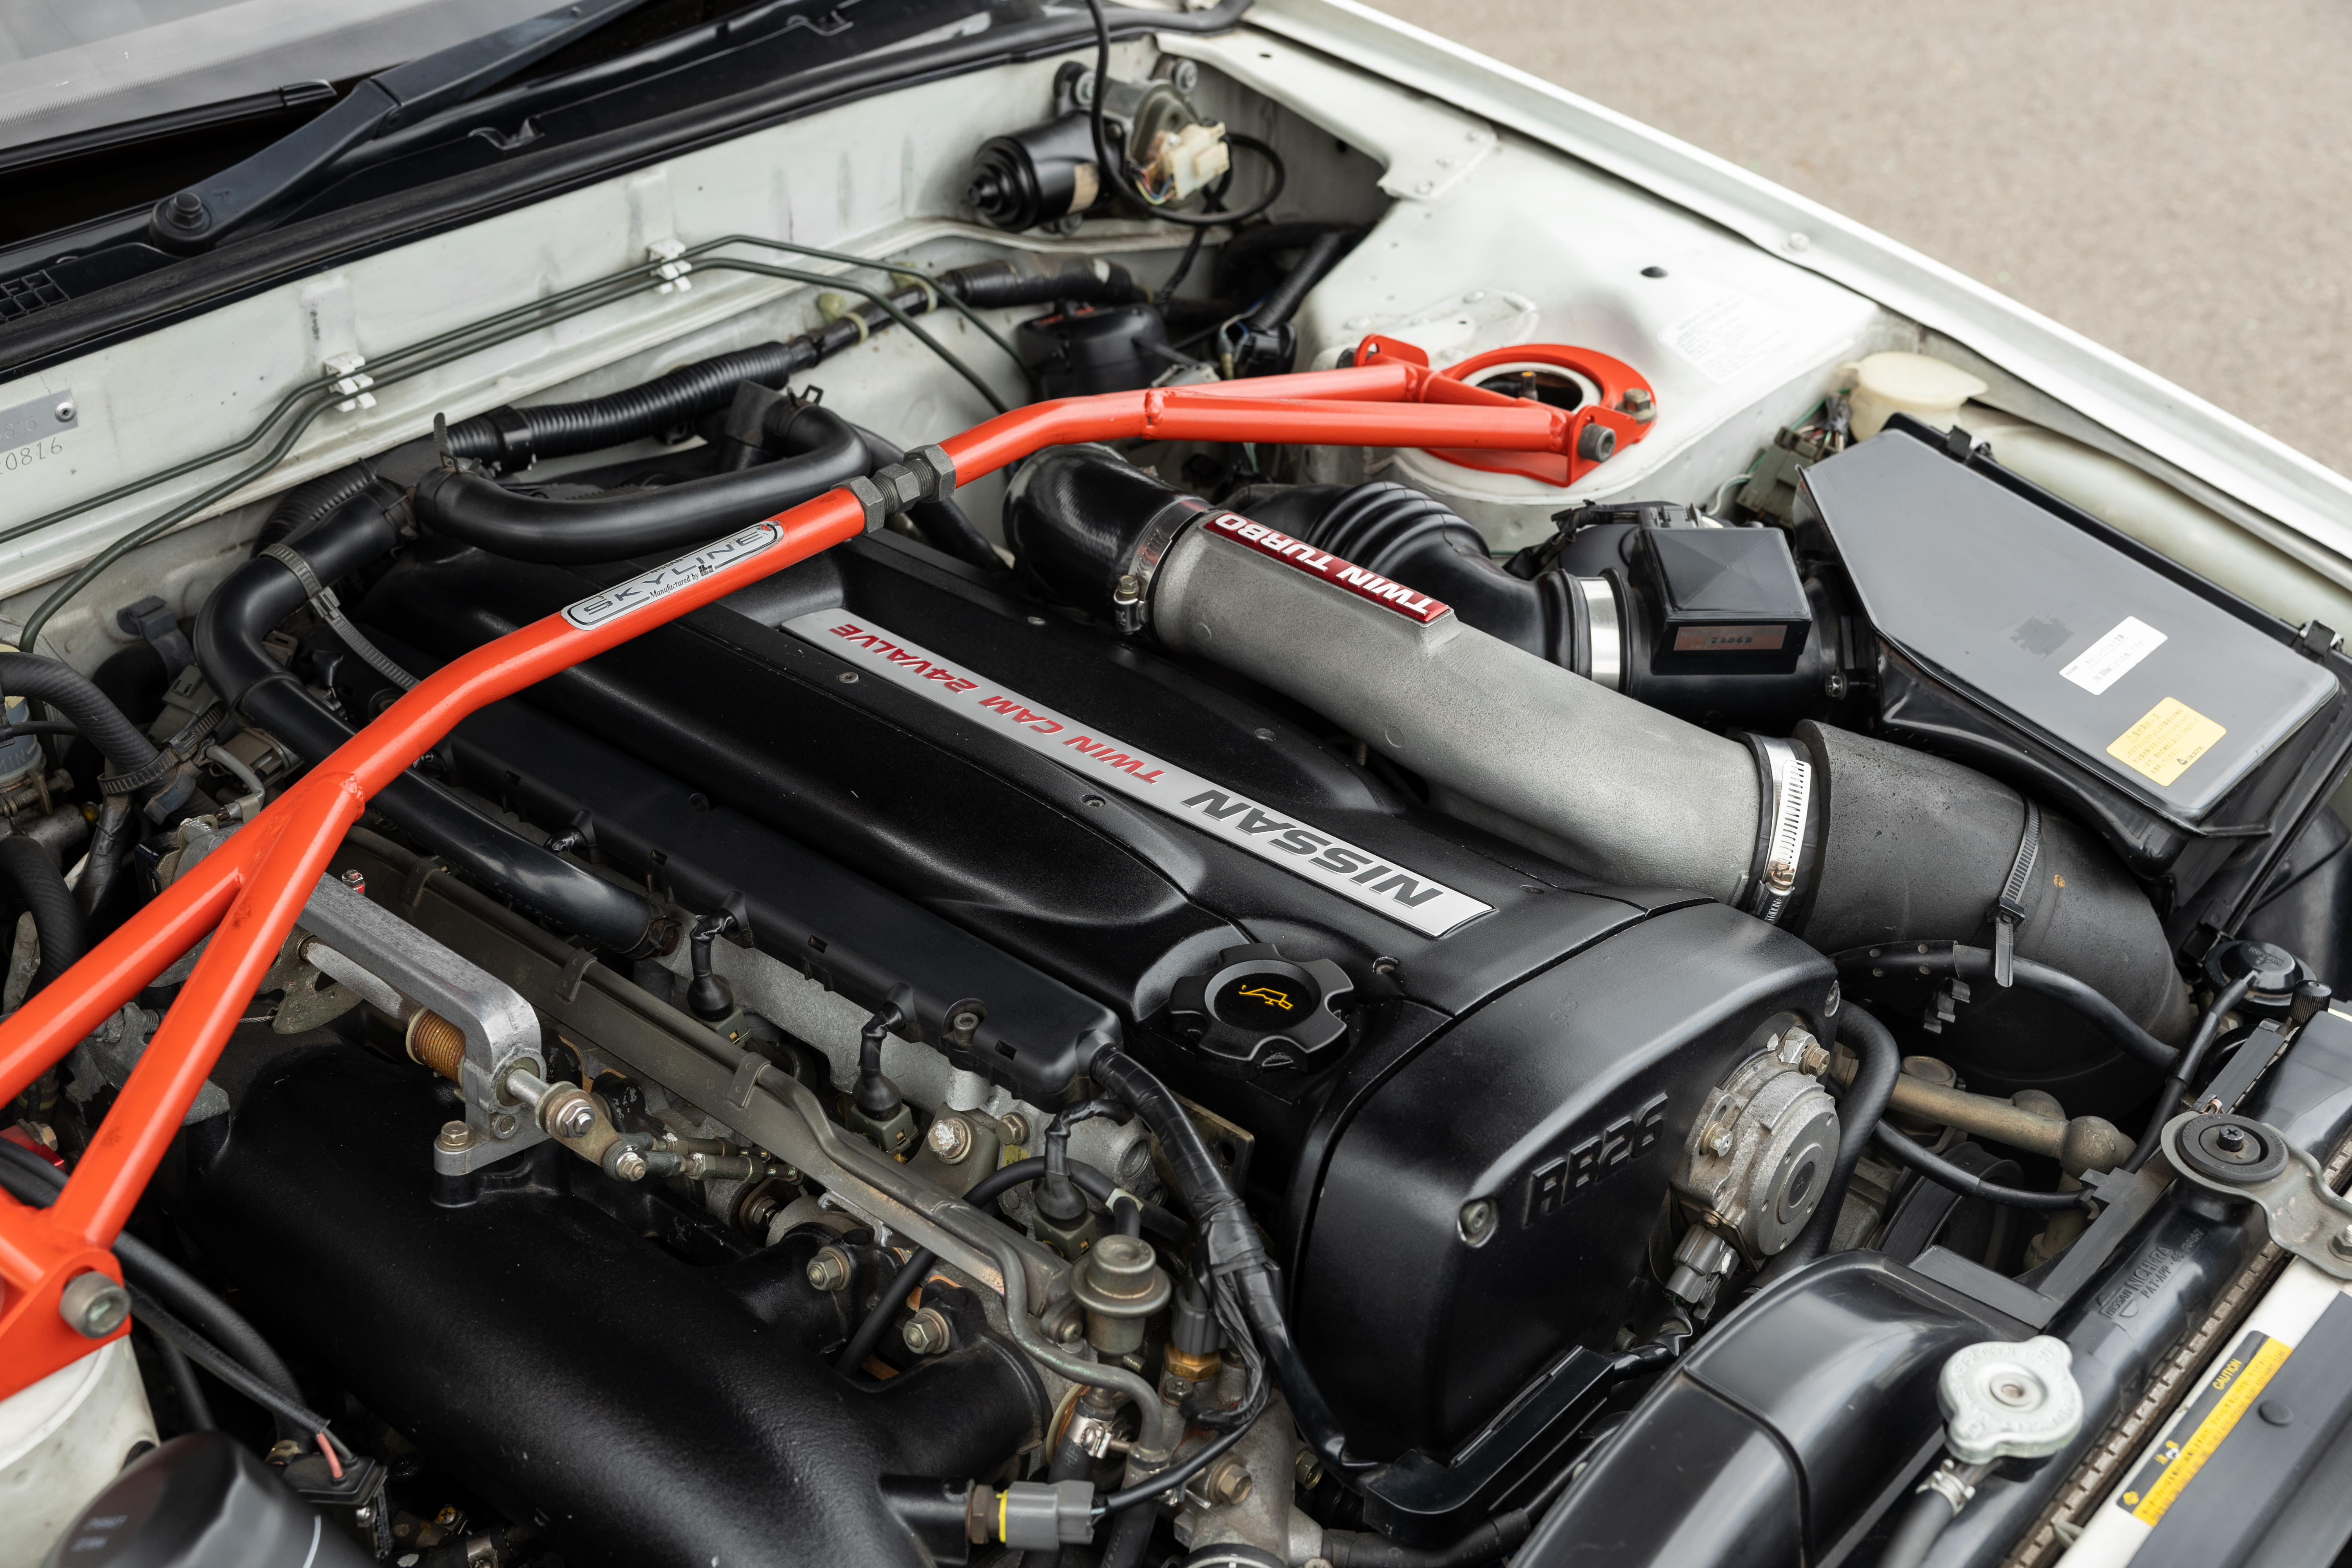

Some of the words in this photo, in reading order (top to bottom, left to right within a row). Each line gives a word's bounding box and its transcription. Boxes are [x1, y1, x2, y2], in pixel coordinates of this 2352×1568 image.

[1215, 513, 1335, 572] TURBO
[583, 531, 763, 615] SKYLINE
[649, 558, 684, 575] NISSAN
[650, 574, 691, 599] Manufactured
[691, 573, 699, 581] by
[1336, 566, 1435, 617] TWIN
[829, 623, 980, 694] 24VALVE
[2064, 665, 2078, 676] NISSAN
[979, 695, 1065, 735] CAM
[1063, 735, 1166, 784] TWIN
[1181, 789, 1444, 909] NISSAN
[1764, 900, 1782, 920] TRIDON
[1523, 1092, 1668, 1227] RB26
[2104, 1287, 2133, 1317] NISSAN
[2212, 1357, 2243, 1390] CAUTION
